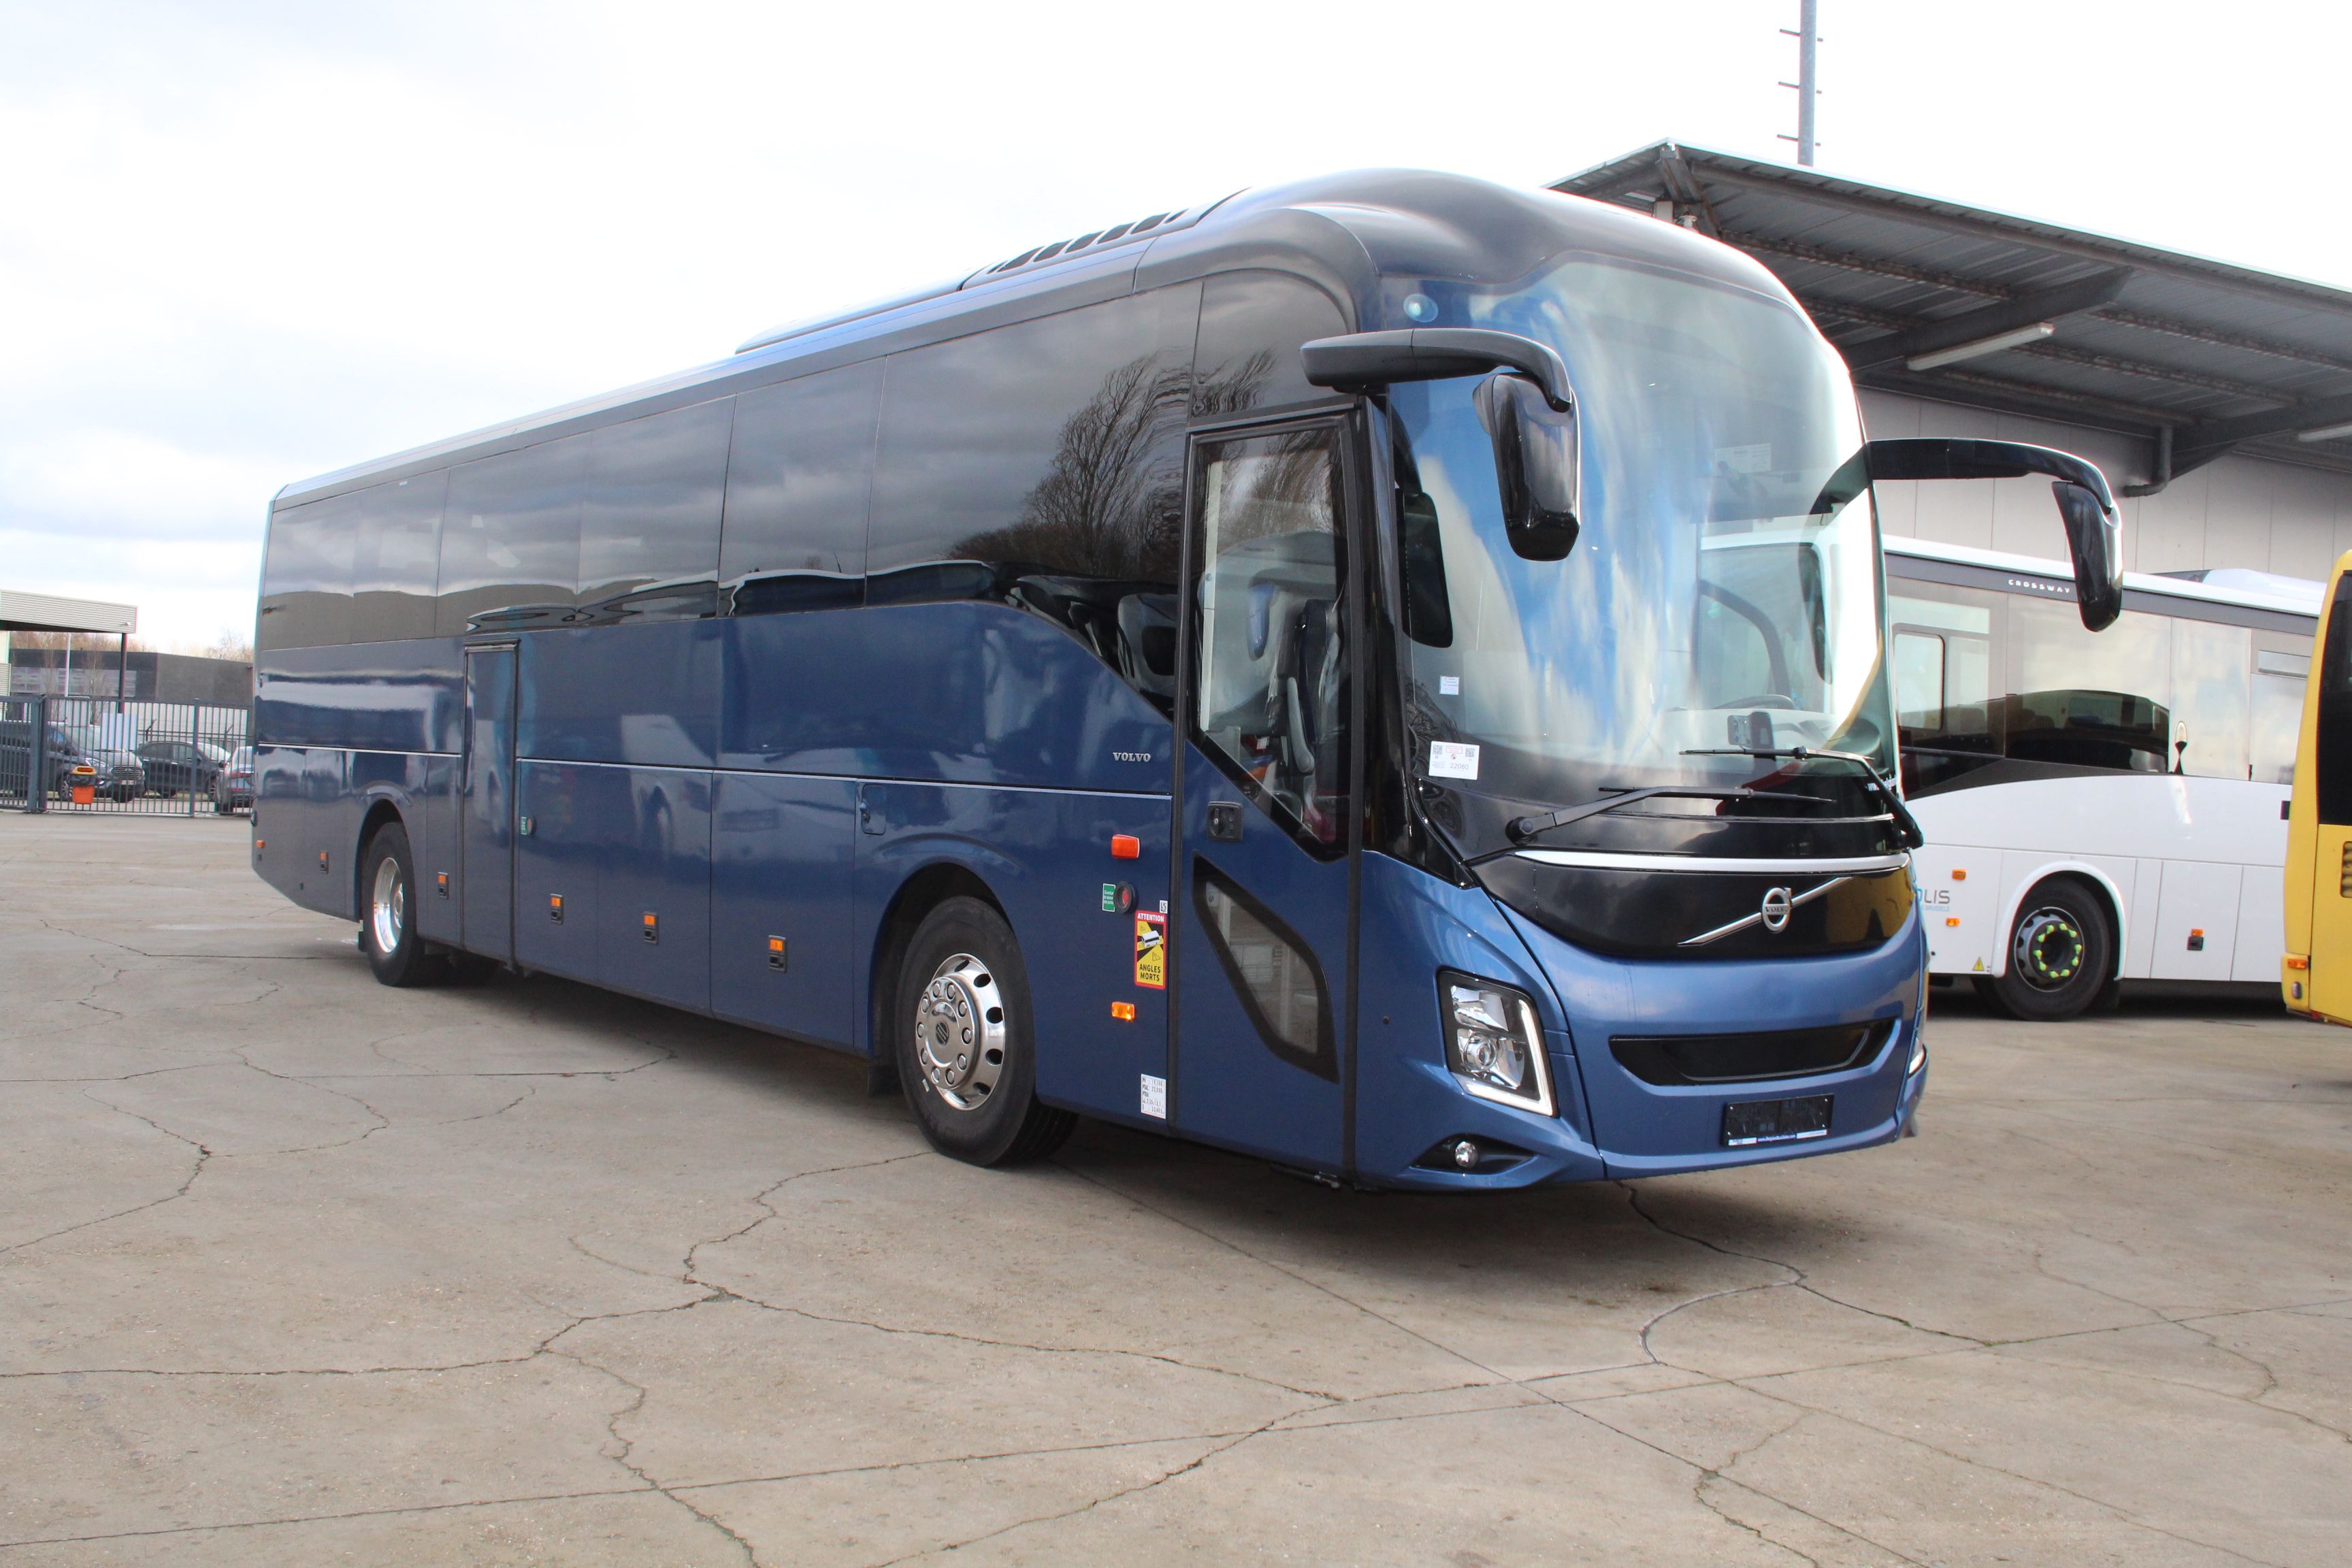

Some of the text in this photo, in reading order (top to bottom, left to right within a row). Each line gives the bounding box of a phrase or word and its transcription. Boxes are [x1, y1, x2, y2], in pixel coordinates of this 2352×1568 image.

[2008, 579, 2070, 593] CROSSWAY
[1112, 752, 1151, 762] VOLVO
[1137, 913, 1164, 922] ATTENTION
[1139, 964, 1161, 973] ANGLES
[1140, 973, 1160, 981] MORTS
